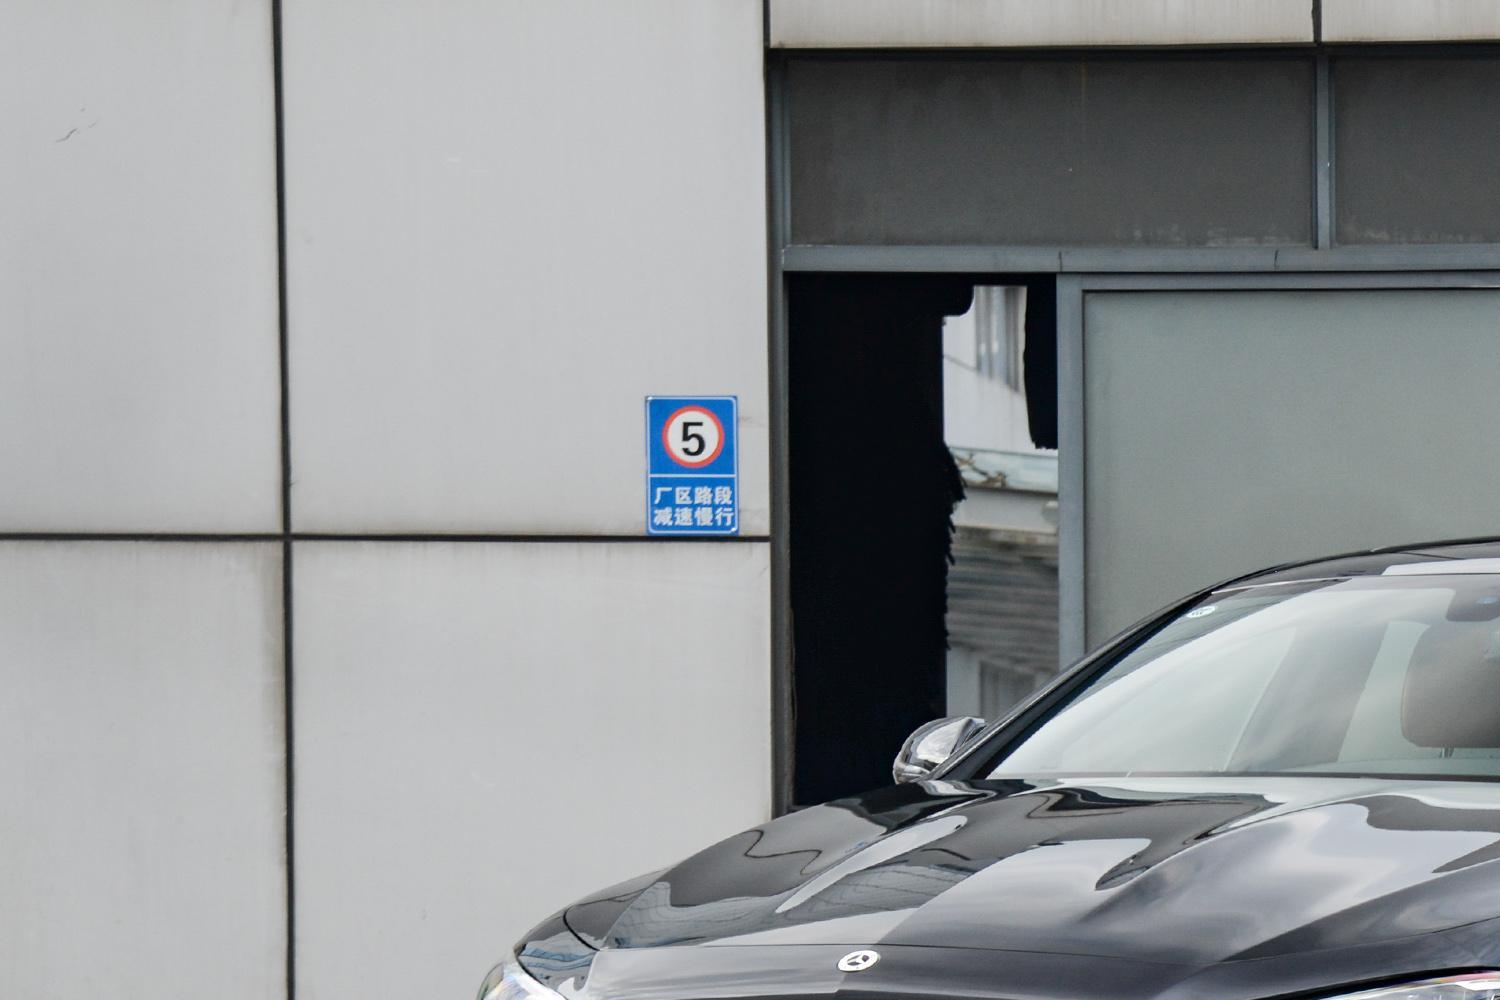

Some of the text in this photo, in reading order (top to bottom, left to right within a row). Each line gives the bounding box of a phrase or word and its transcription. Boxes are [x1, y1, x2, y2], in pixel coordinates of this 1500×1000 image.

[682, 421, 705, 456] 5
[654, 486, 732, 504] 厂区路段
[654, 507, 734, 526] 减速慢行
